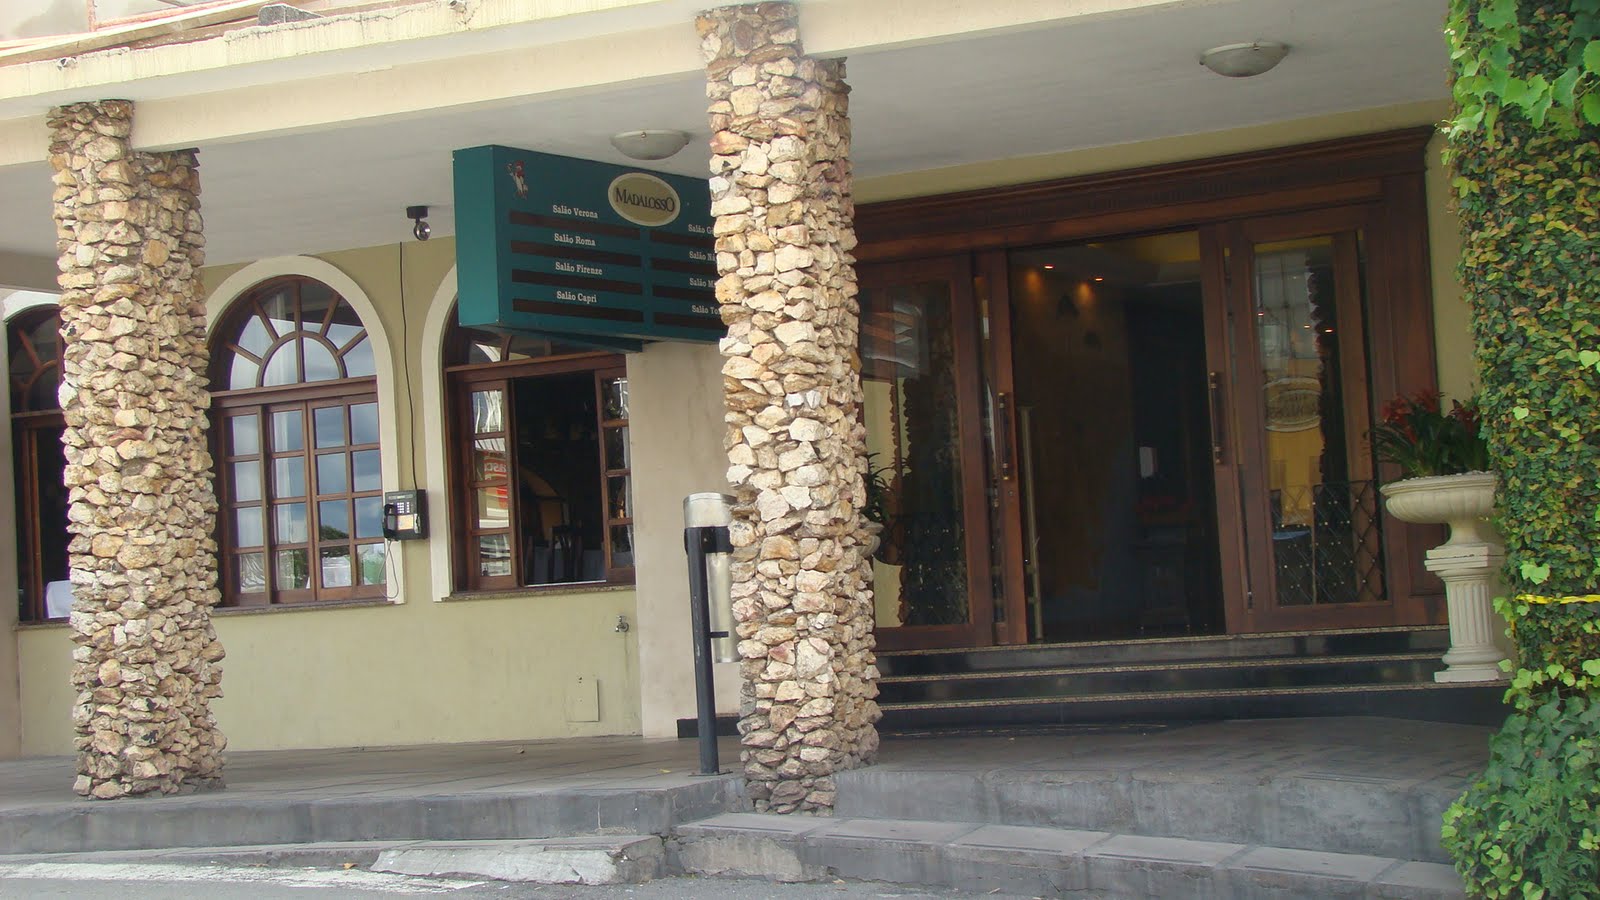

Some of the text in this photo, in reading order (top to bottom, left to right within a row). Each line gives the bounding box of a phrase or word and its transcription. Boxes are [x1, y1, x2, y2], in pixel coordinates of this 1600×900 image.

[615, 187, 675, 212] MADALOSSO
[552, 204, 599, 219] Salão Verona
[688, 223, 706, 234] Salão
[554, 232, 596, 246] Salão Roma
[689, 250, 707, 261] Salão
[555, 261, 603, 275] Salão Firenze
[689, 277, 707, 288] Salão
[556, 290, 597, 305] Salão Capri
[691, 304, 709, 314] Salão
